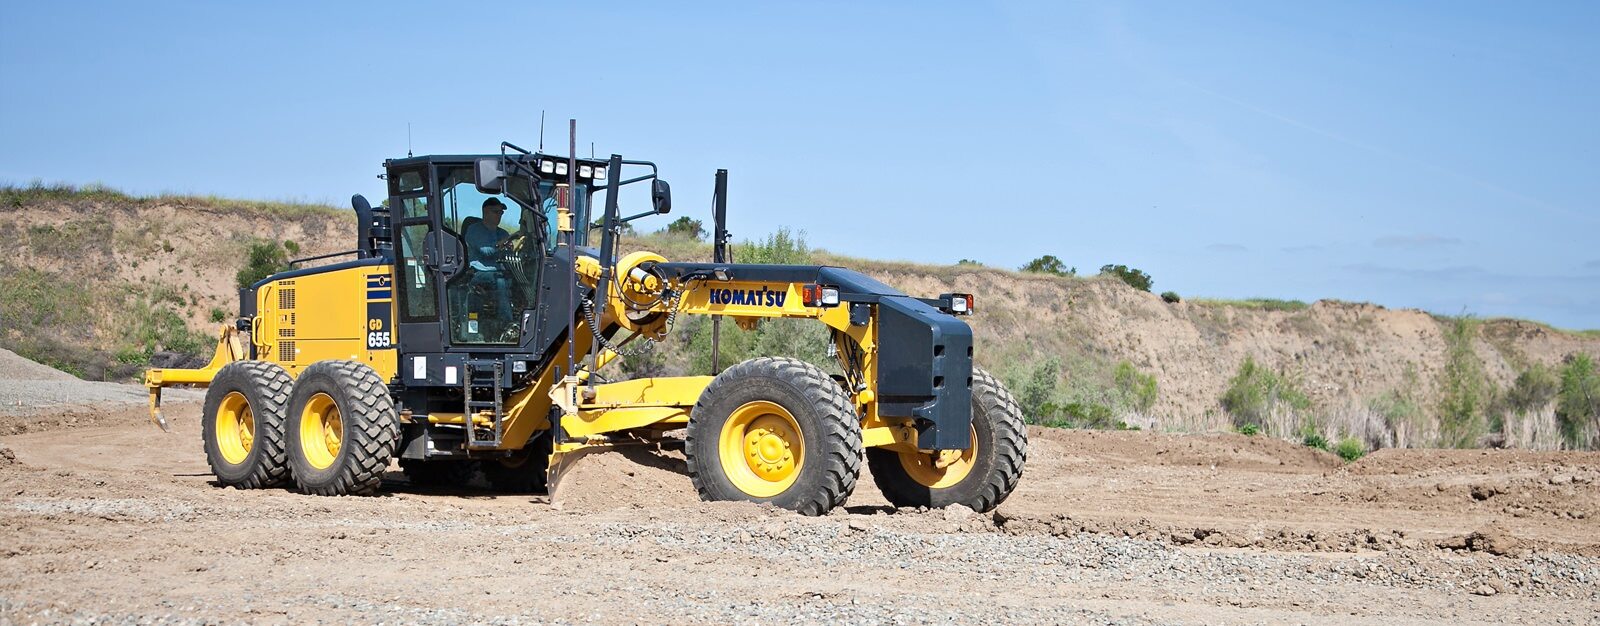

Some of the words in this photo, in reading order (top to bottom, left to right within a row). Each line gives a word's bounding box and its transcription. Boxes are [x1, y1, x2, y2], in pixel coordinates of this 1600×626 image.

[710, 286, 787, 307] KOMATSU
[369, 319, 383, 331] GD
[368, 331, 390, 347] 655
